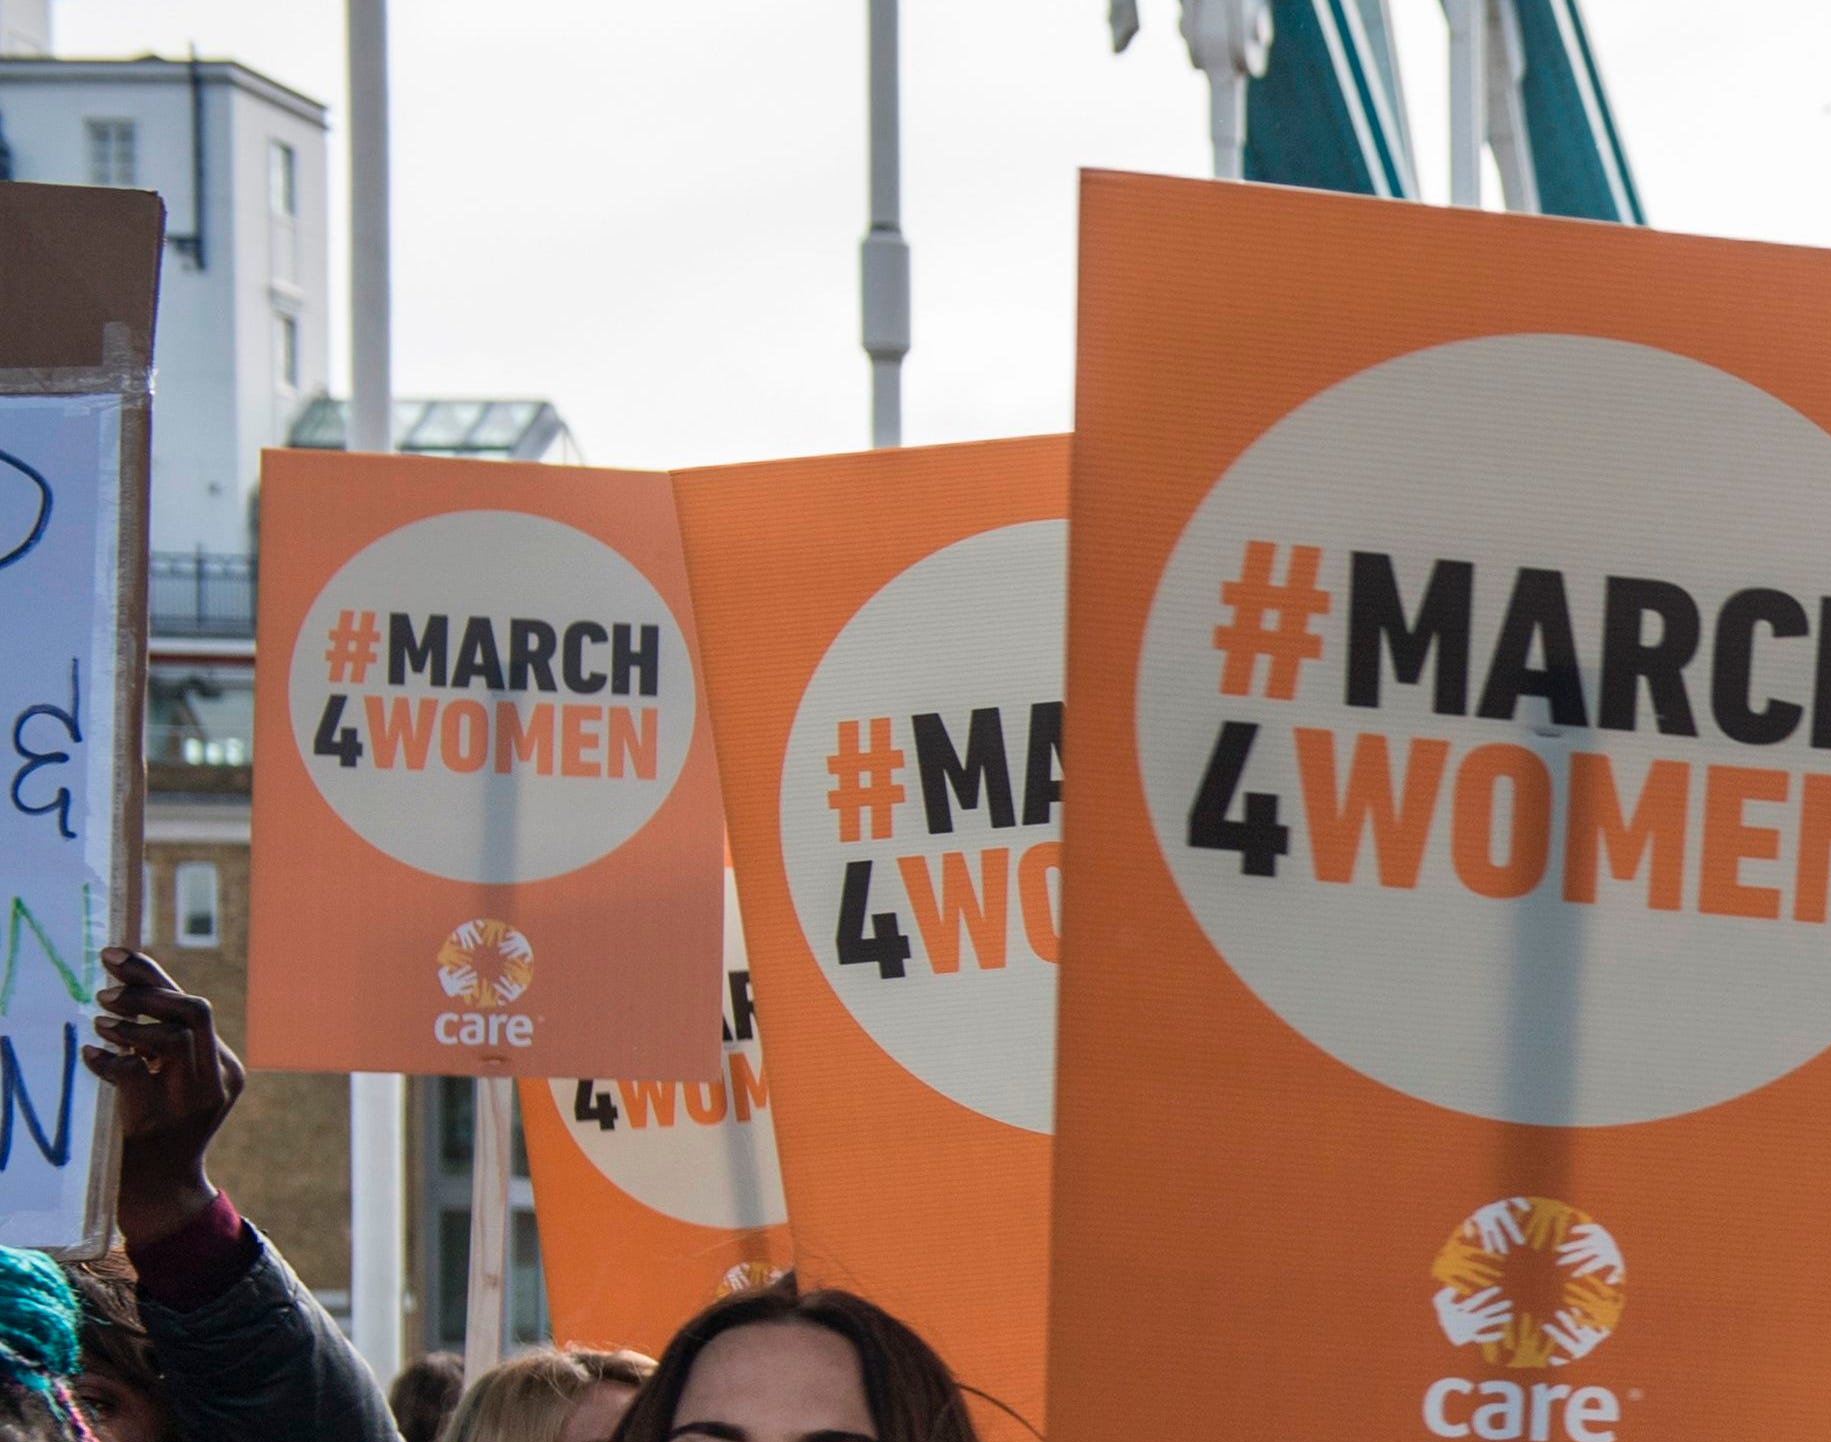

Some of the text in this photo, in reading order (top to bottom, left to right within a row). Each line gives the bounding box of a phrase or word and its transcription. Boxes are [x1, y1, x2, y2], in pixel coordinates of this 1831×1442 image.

[325, 610, 660, 697] #MARCH
[313, 694, 659, 782] 4WOMEN
[433, 1011, 534, 1049] care
